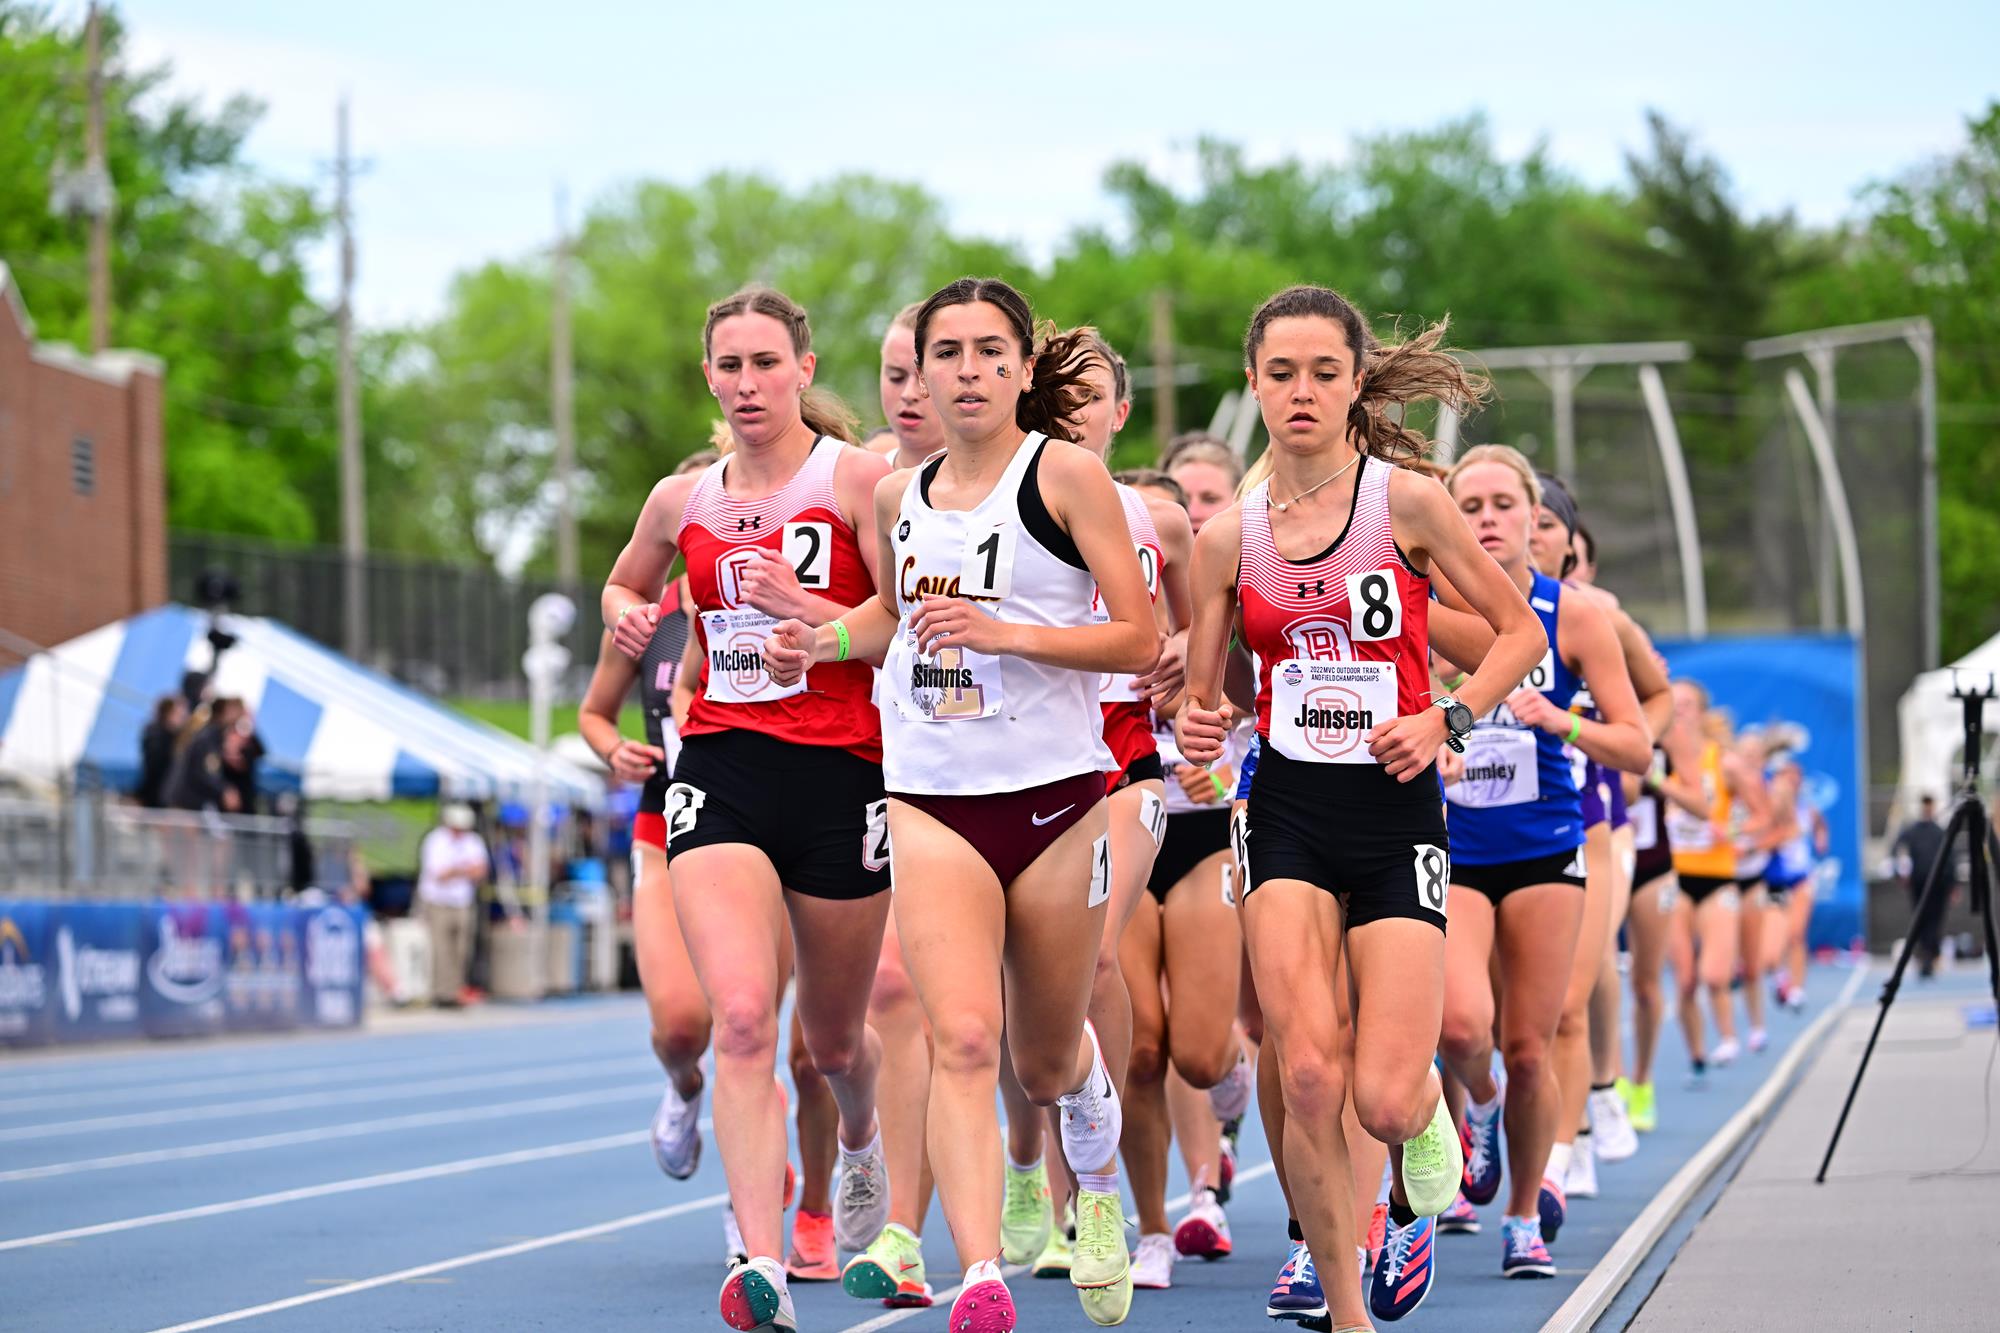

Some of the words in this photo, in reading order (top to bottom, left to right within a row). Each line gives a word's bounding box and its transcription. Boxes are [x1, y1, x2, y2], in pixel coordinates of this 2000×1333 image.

[794, 526, 820, 584] 2
[977, 533, 1000, 590] 1
[1360, 574, 1393, 638] 8
[713, 650, 764, 671] McDon
[913, 664, 972, 688] Simms
[1295, 704, 1373, 730] Jansen
[1460, 762, 1517, 783] umley
[673, 787, 693, 829] 2
[1100, 840, 1108, 895] 1
[1422, 847, 1443, 909] 8
